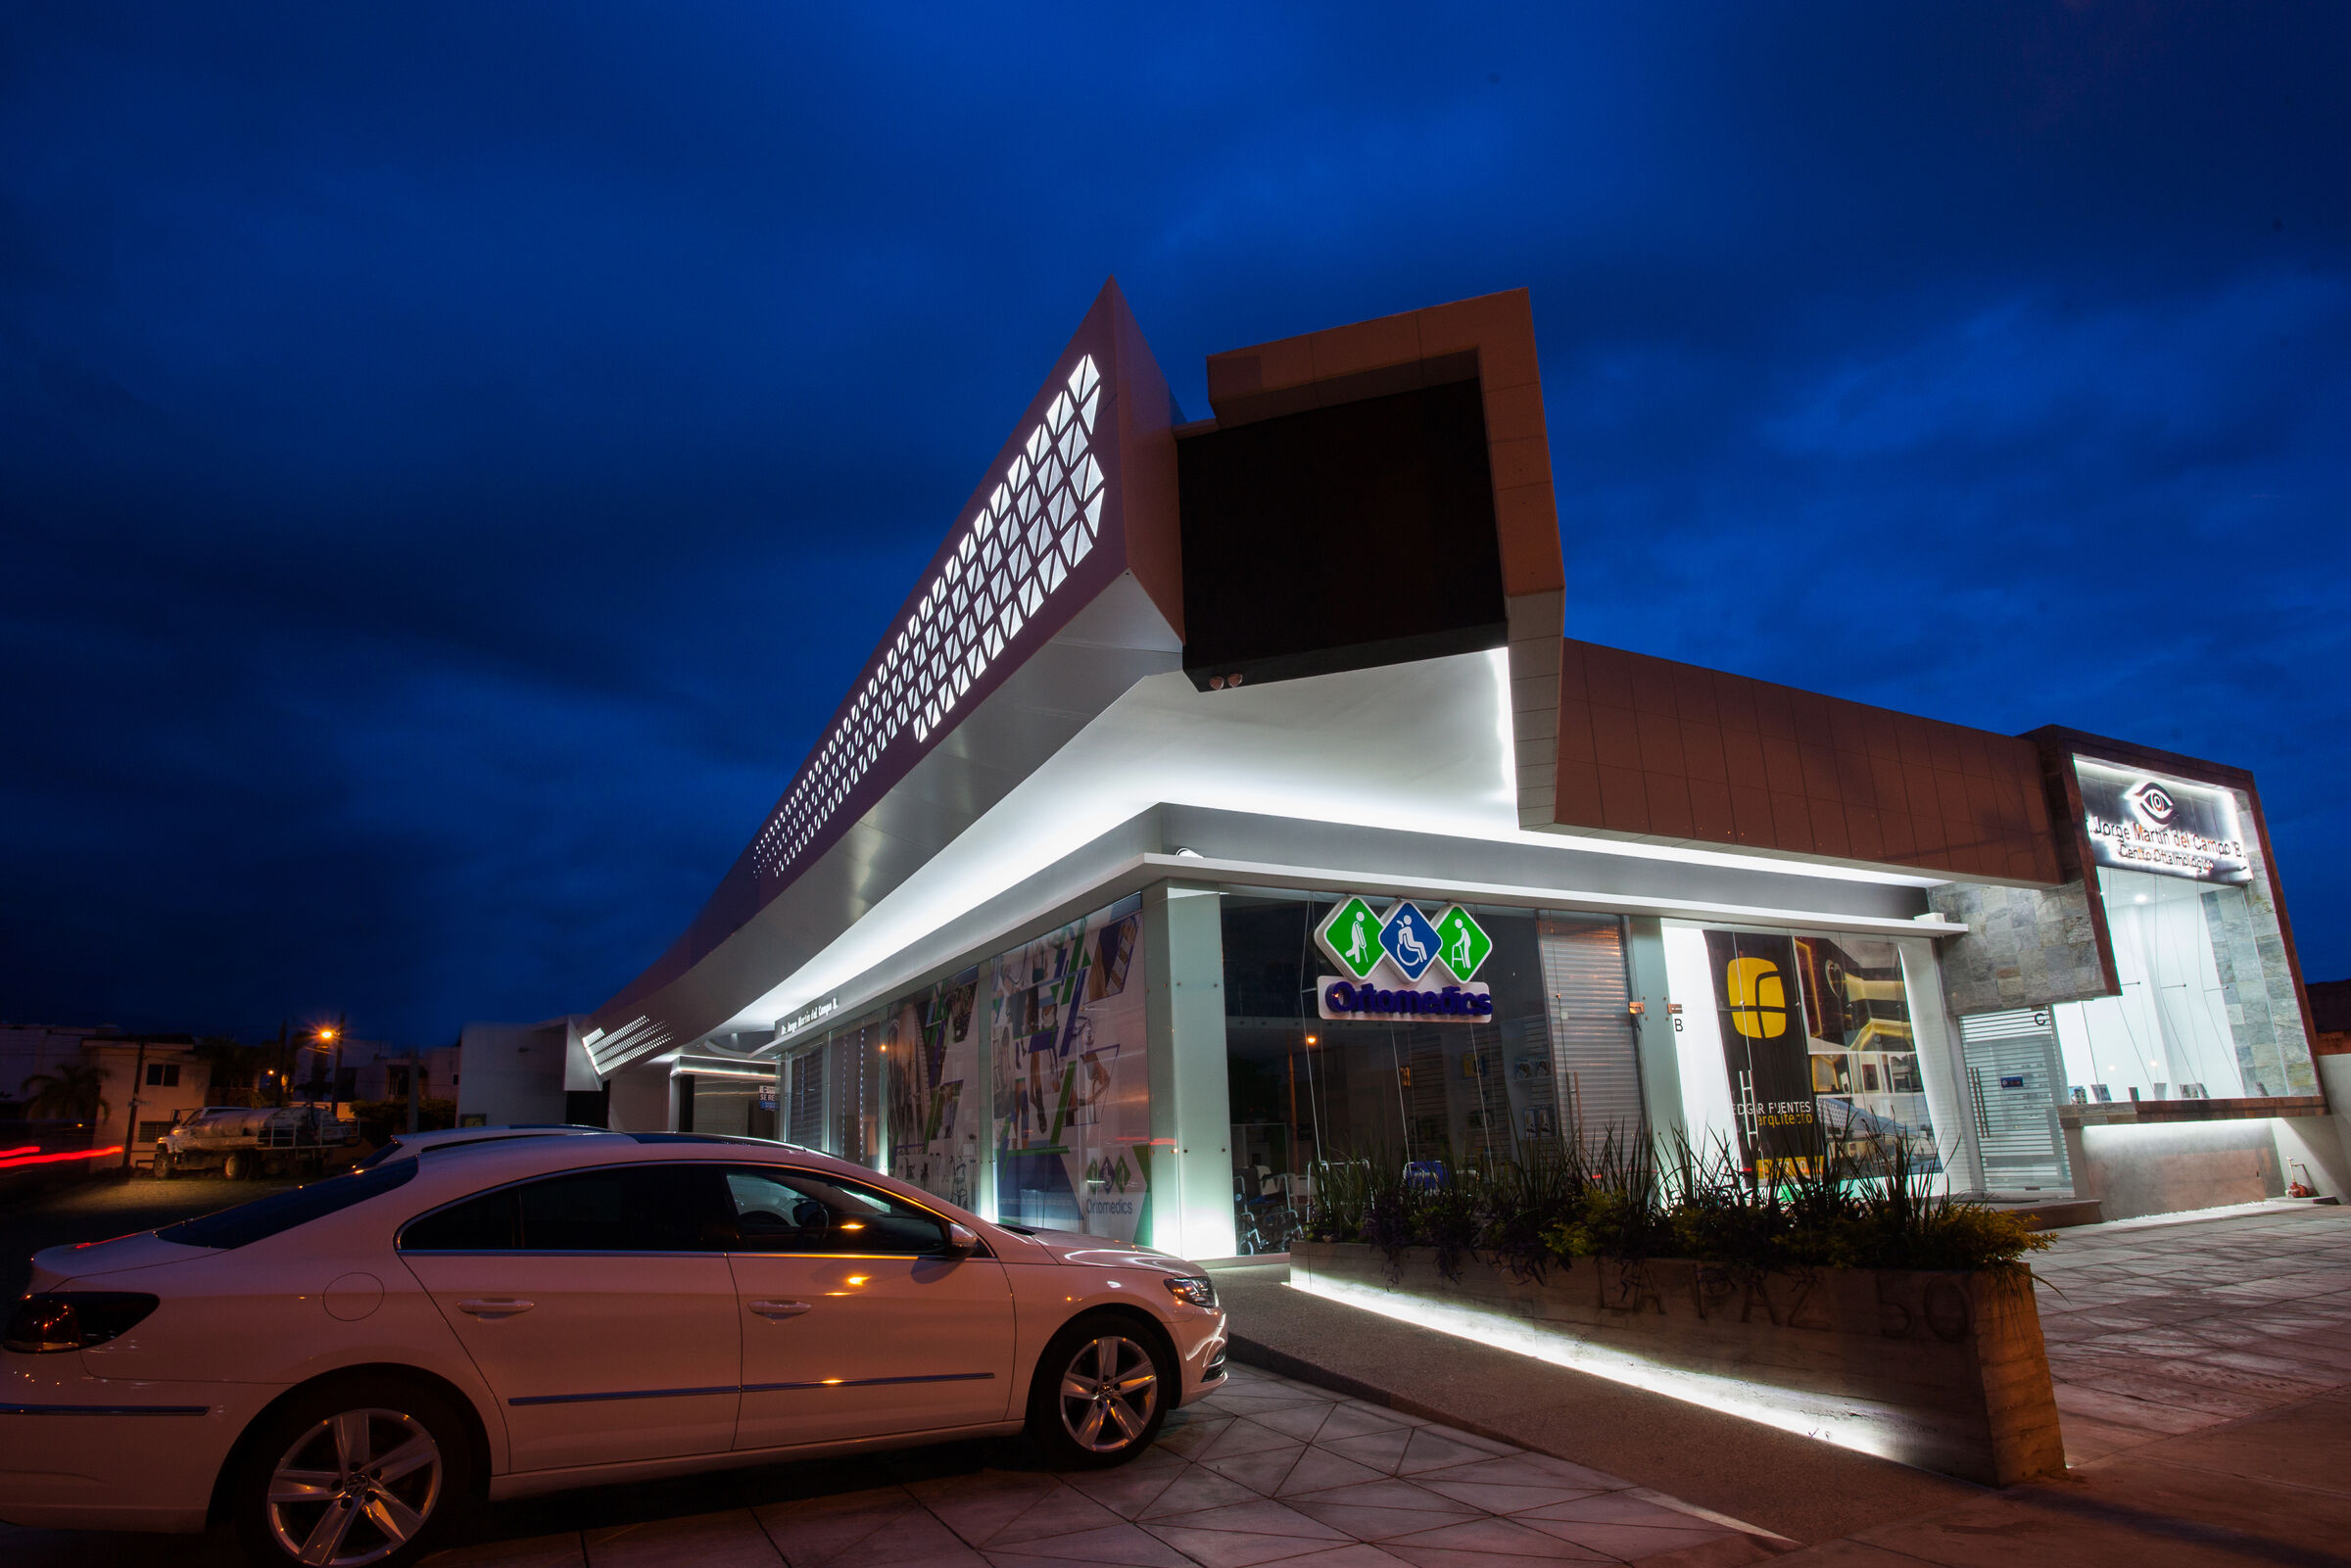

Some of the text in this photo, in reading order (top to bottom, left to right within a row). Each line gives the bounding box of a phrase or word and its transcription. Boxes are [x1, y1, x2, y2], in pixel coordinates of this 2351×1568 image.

[2092, 816, 2131, 843] Jorge
[2174, 829, 2190, 848] del
[2192, 833, 2231, 859] Campo
[2118, 843, 2151, 862] Centro
[1325, 981, 1493, 1016] Ortomedics
[1674, 1019, 1684, 1032] B
[1768, 1101, 1811, 1115] FUENTES
[1757, 1114, 1812, 1128] arquitecto
[1086, 1198, 1133, 1215] Ortomedics
